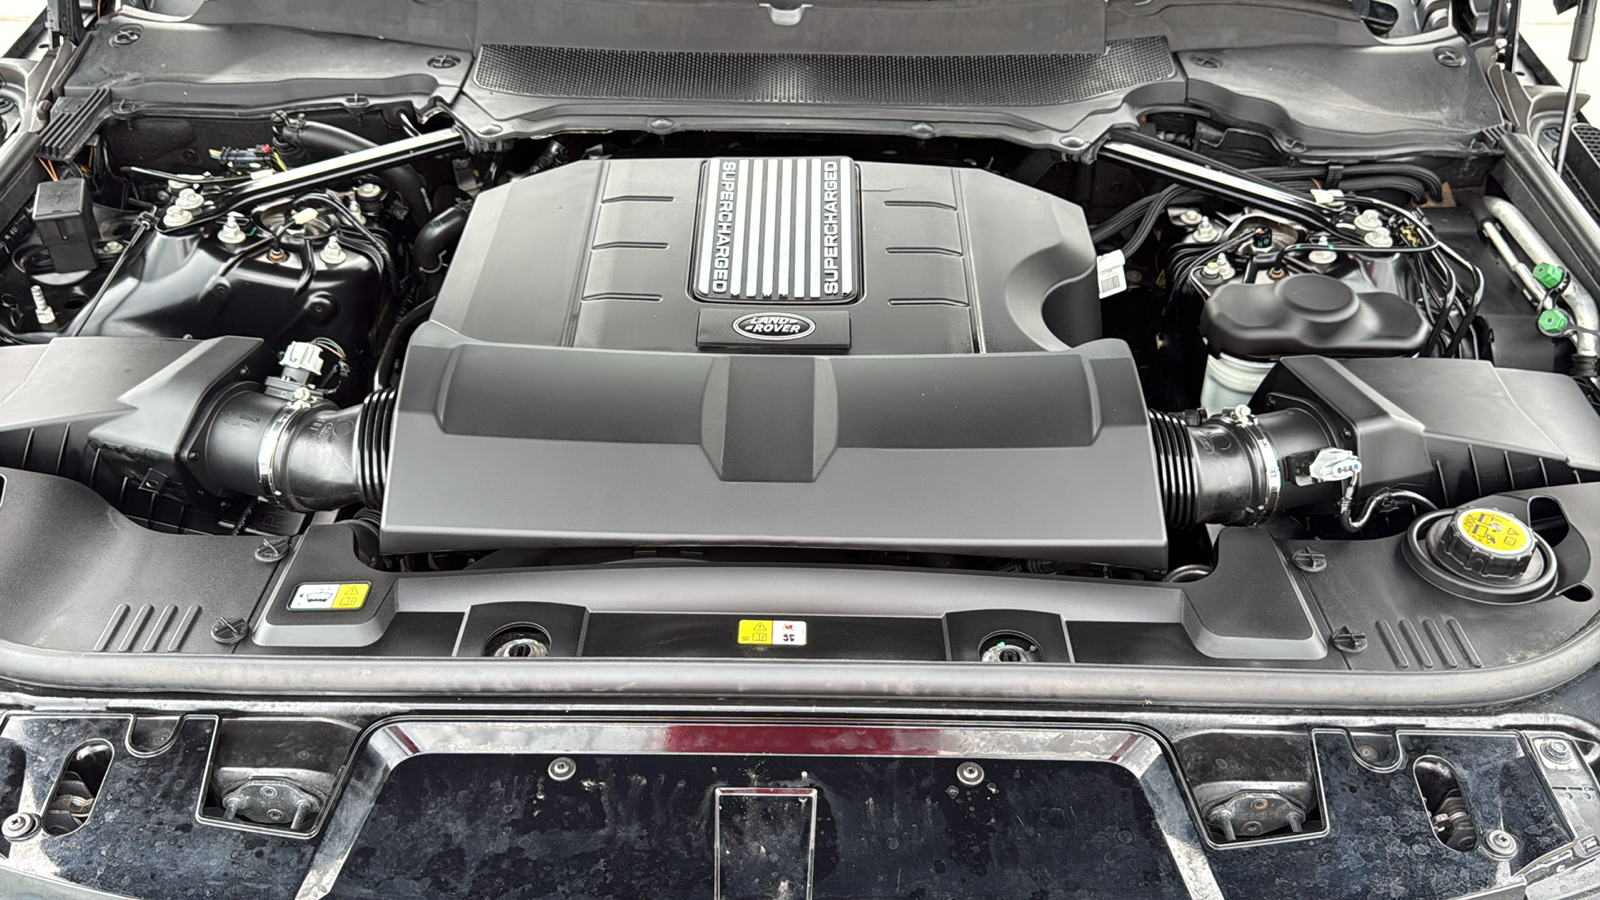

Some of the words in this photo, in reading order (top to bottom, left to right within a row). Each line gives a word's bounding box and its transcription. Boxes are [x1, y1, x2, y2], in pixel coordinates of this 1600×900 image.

[713, 161, 736, 293] SUPERCHARGED
[823, 161, 839, 296] SUPERCHARGED
[750, 316, 790, 325] LAND
[752, 324, 801, 333] ROVER
